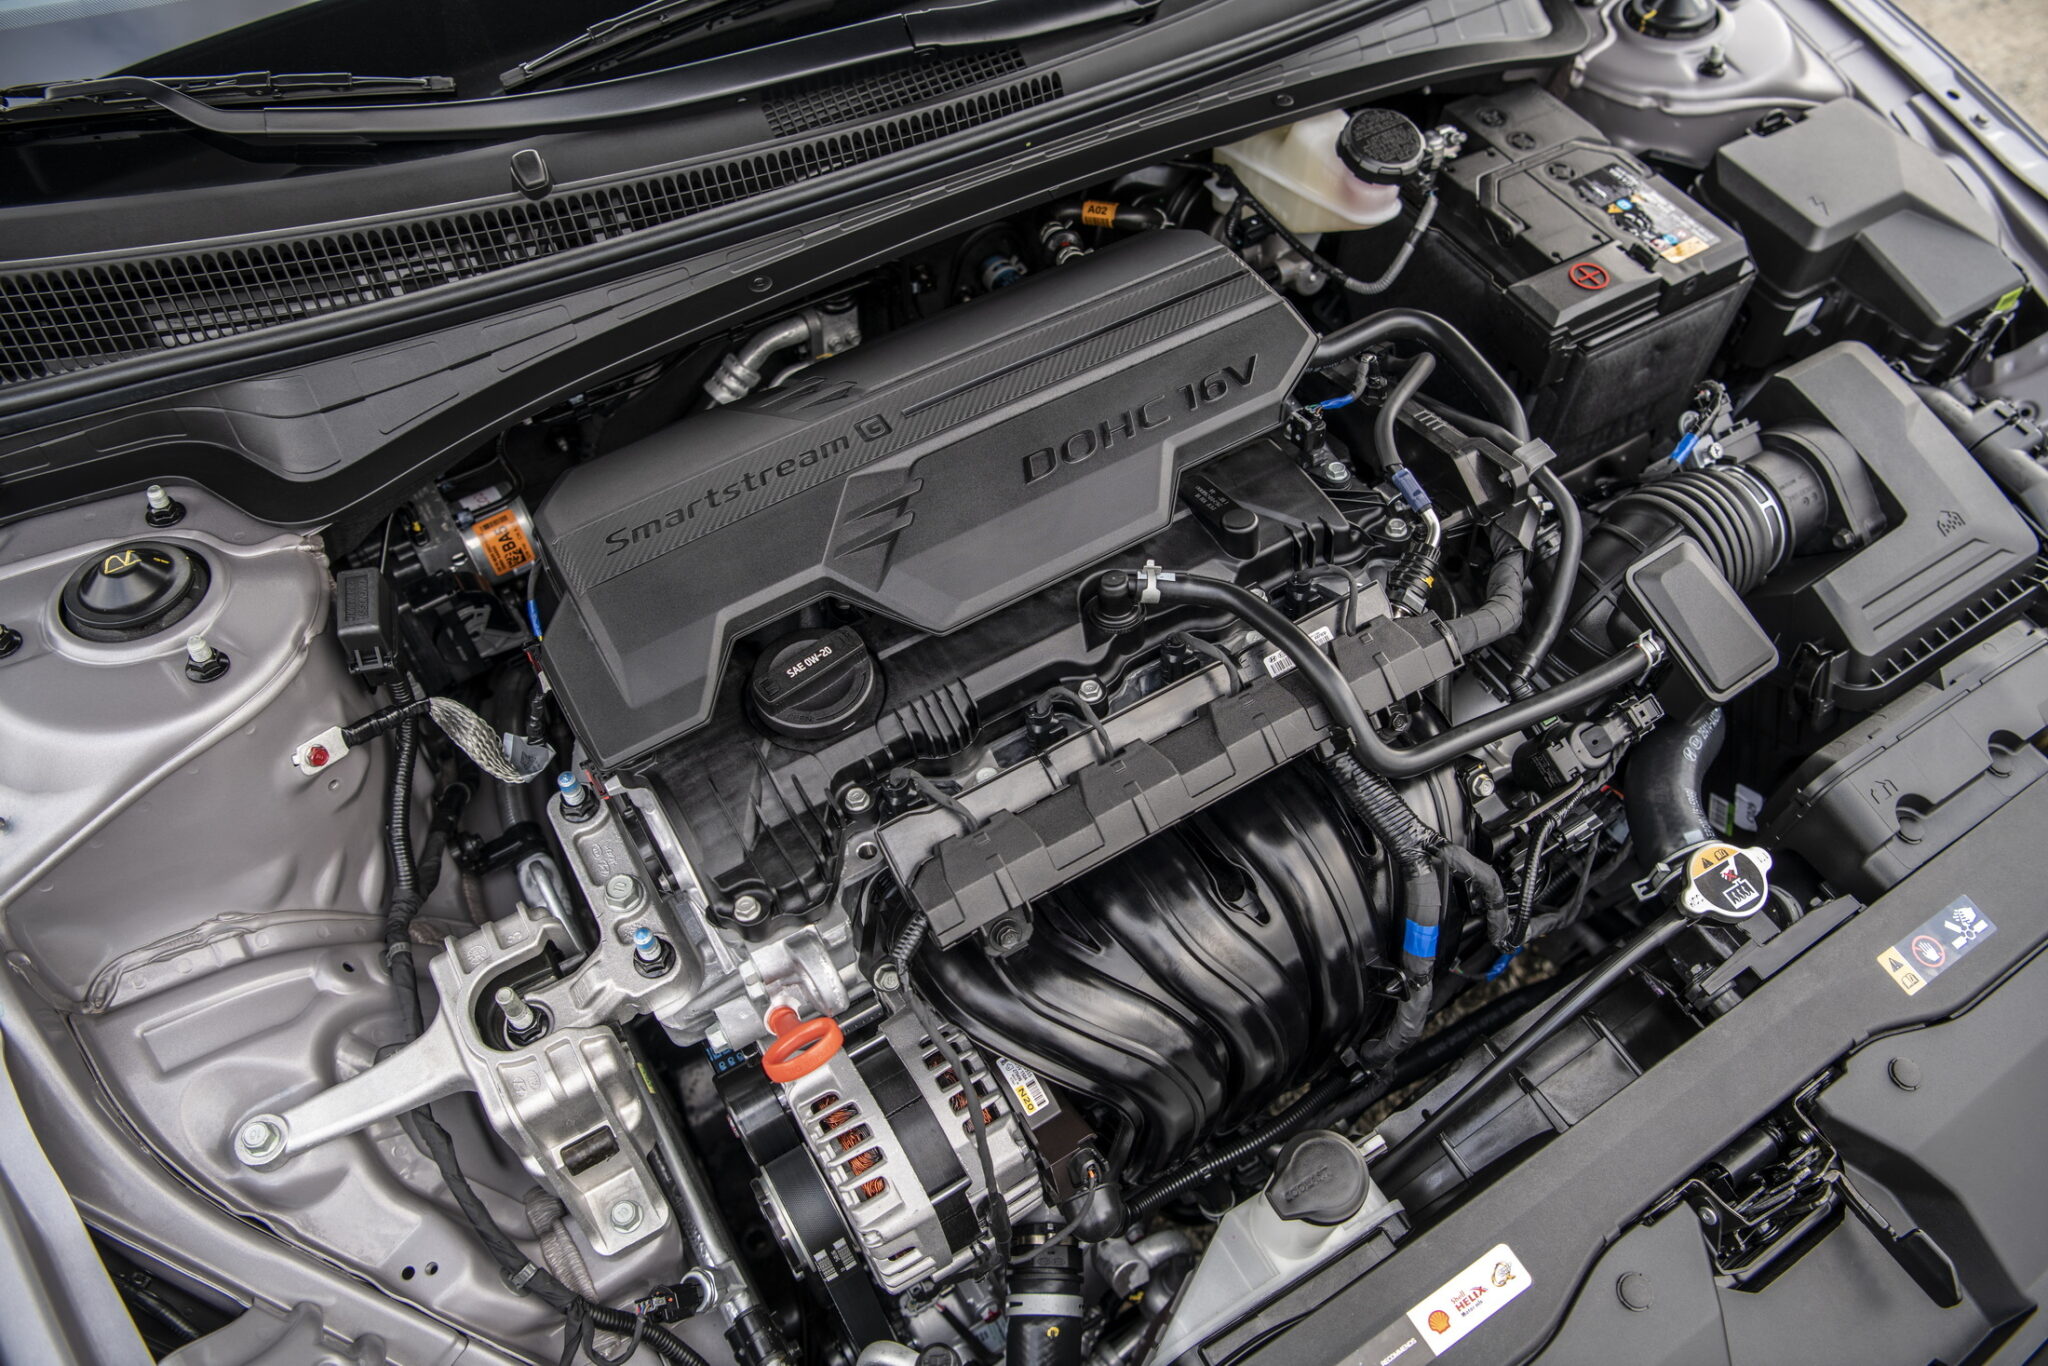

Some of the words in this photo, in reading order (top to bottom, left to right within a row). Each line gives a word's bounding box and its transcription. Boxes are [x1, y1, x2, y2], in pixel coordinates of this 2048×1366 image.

[1088, 205, 1107, 215] A02
[1022, 394, 1171, 486] DOHC
[1176, 353, 1259, 412] 16V
[605, 435, 850, 556] Smartstream
[786, 662, 806, 678] SAE
[803, 646, 833, 667] 0W-20
[1450, 1289, 1466, 1304] Shell
[1455, 1286, 1487, 1312] HELIX
[1380, 1338, 1417, 1366] RECOMMENDS
